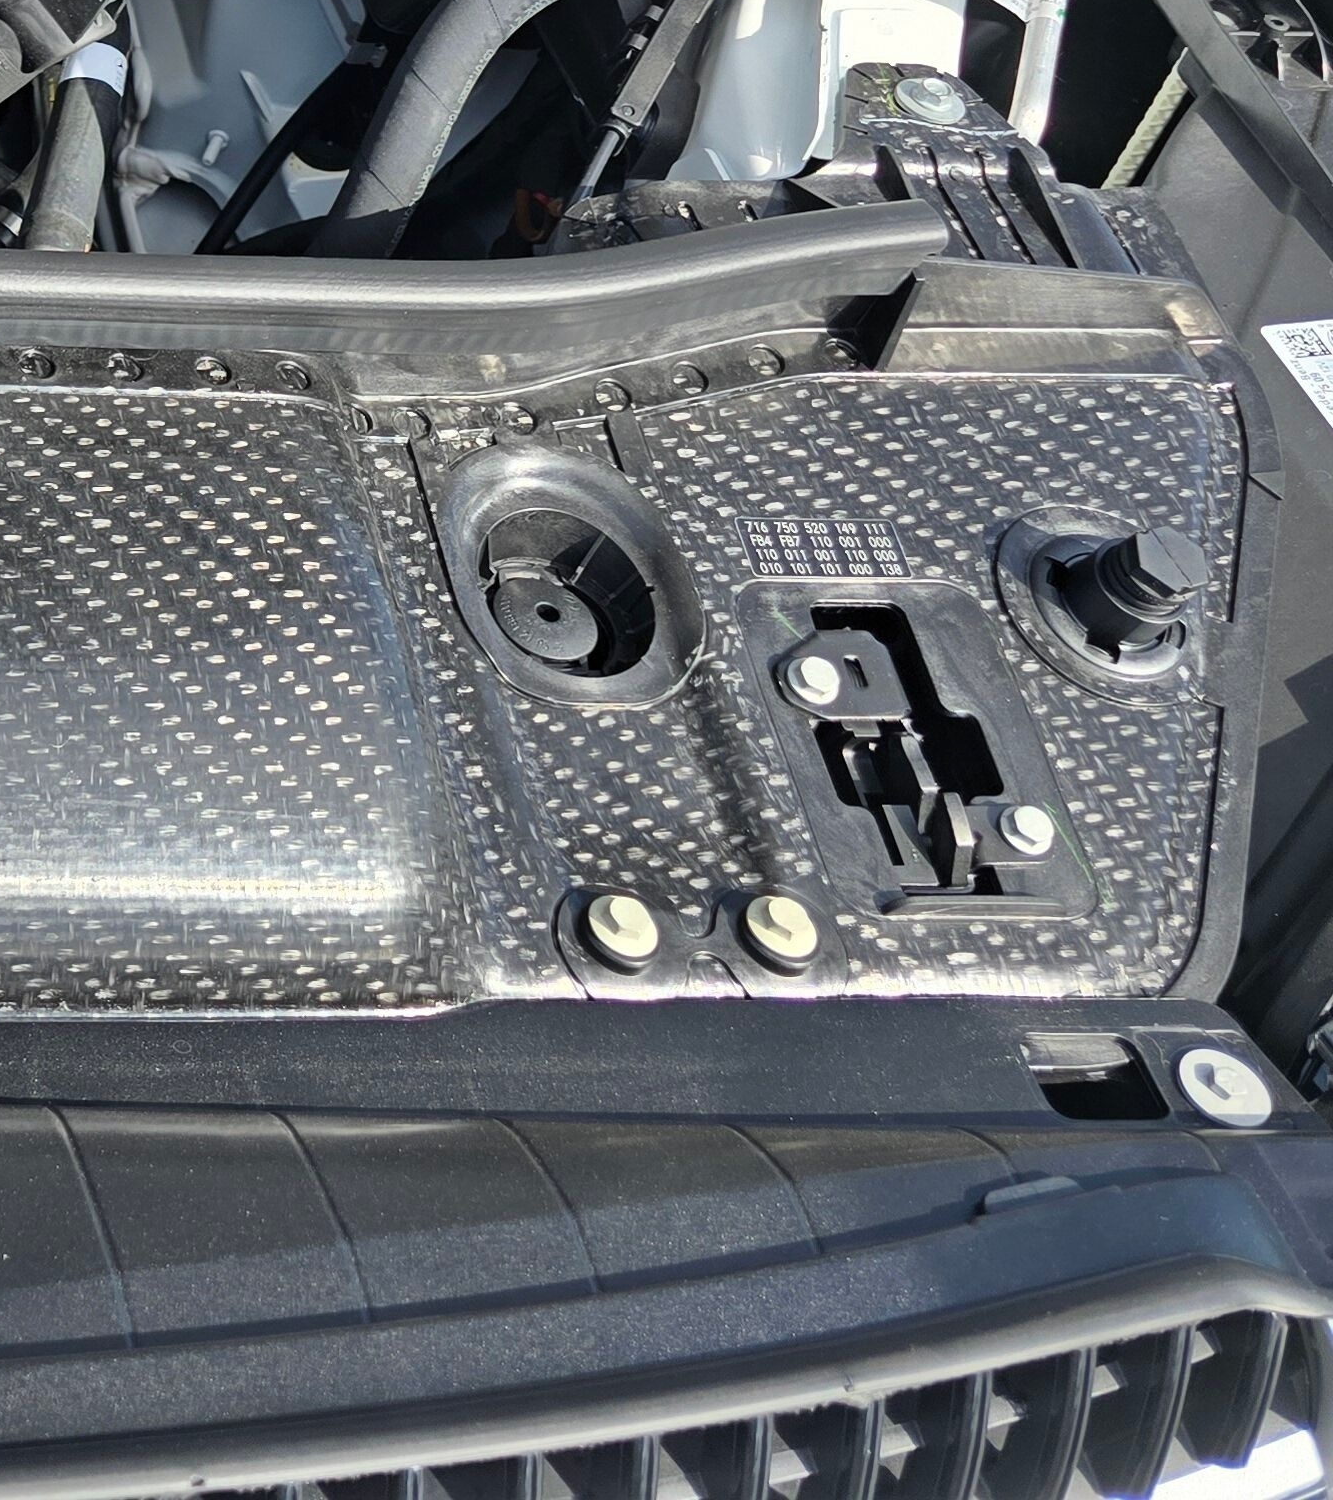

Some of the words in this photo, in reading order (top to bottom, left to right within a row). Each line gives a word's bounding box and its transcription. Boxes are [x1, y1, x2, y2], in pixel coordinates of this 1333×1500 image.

[744, 521, 769, 534] 716
[774, 522, 799, 533] 750
[804, 522, 827, 534] 520
[834, 523, 857, 534] 149
[863, 523, 886, 534] 111
[750, 535, 773, 547] FB4
[780, 536, 801, 547] FB7
[810, 536, 833, 547] 110
[838, 537, 863, 548] 001
[868, 537, 892, 548] 000
[755, 549, 779, 560] 110
[784, 549, 807, 561] 011
[814, 550, 838, 561] 001
[844, 550, 868, 561] 110
[874, 550, 898, 561] 000
[759, 563, 784, 574] 010
[790, 563, 812, 574] 101
[820, 564, 842, 575] 101
[849, 564, 873, 575] 000
[880, 564, 903, 575] 138
